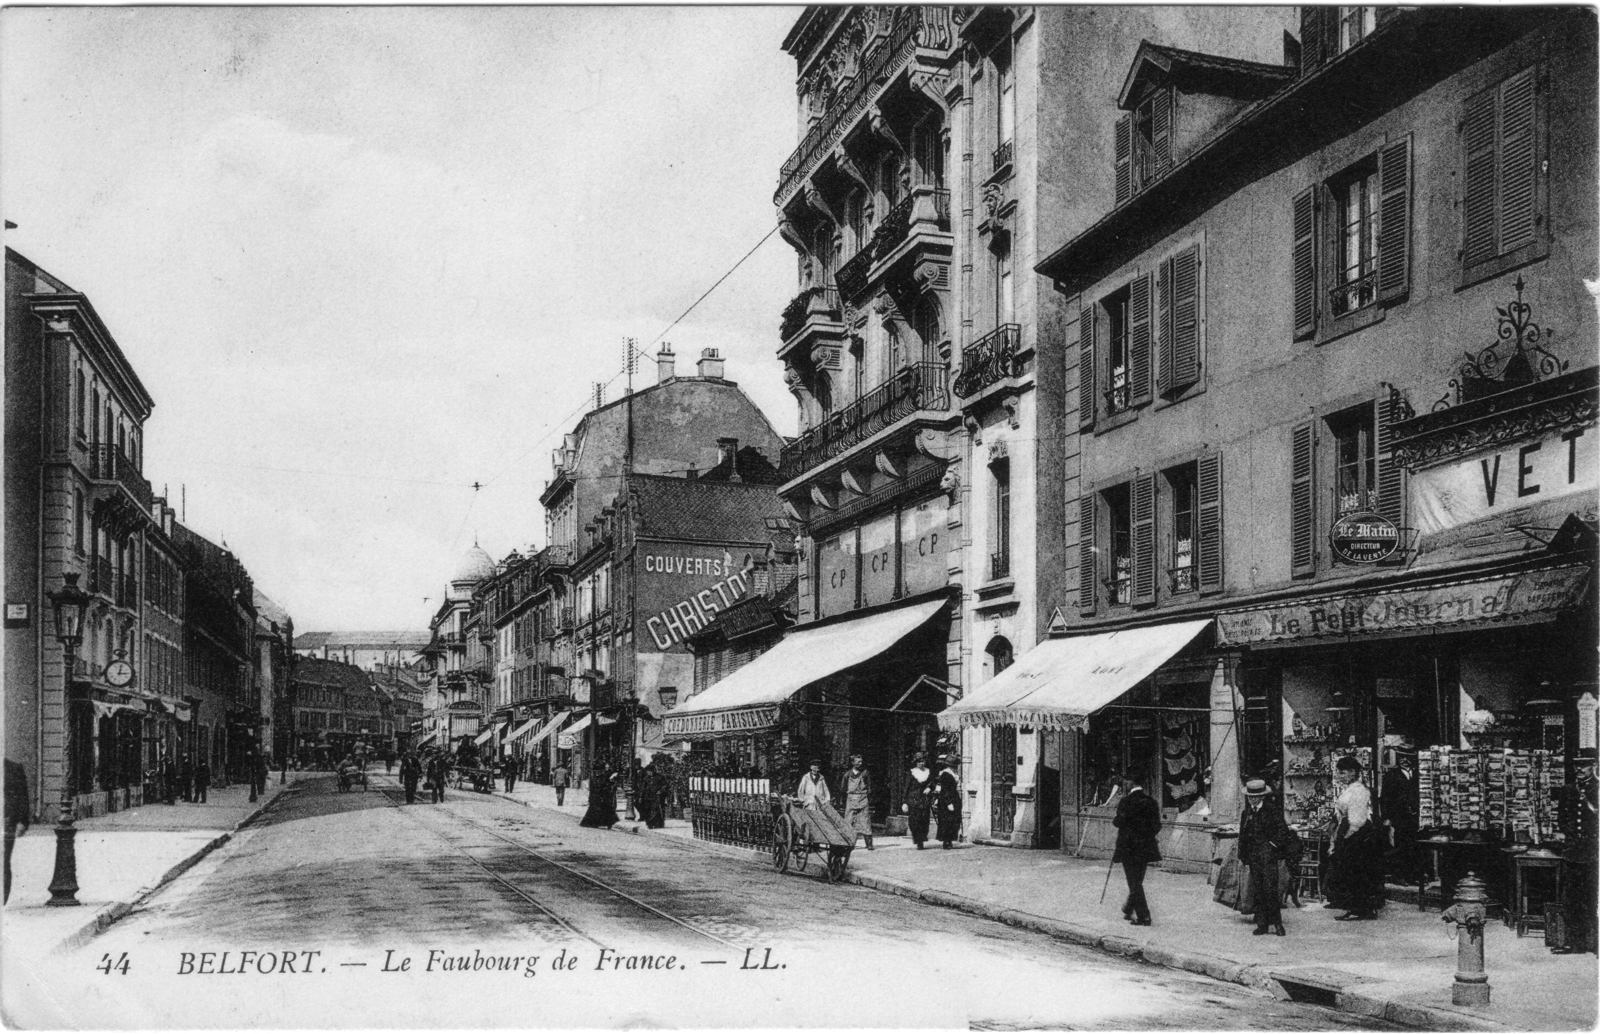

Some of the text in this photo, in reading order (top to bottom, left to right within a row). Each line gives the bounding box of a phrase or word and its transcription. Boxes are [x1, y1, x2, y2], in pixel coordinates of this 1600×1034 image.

[1481, 428, 1585, 507] VET
[1338, 523, 1397, 538] Le Matin
[1342, 548, 1353, 557] DE
[1363, 548, 1388, 560] VENTE
[1350, 542, 1381, 550] DIRECTEUR
[645, 555, 721, 576] COUVERTS
[1270, 613, 1300, 636] Le
[1310, 601, 1365, 632] Petit
[1373, 579, 1523, 624] Journal
